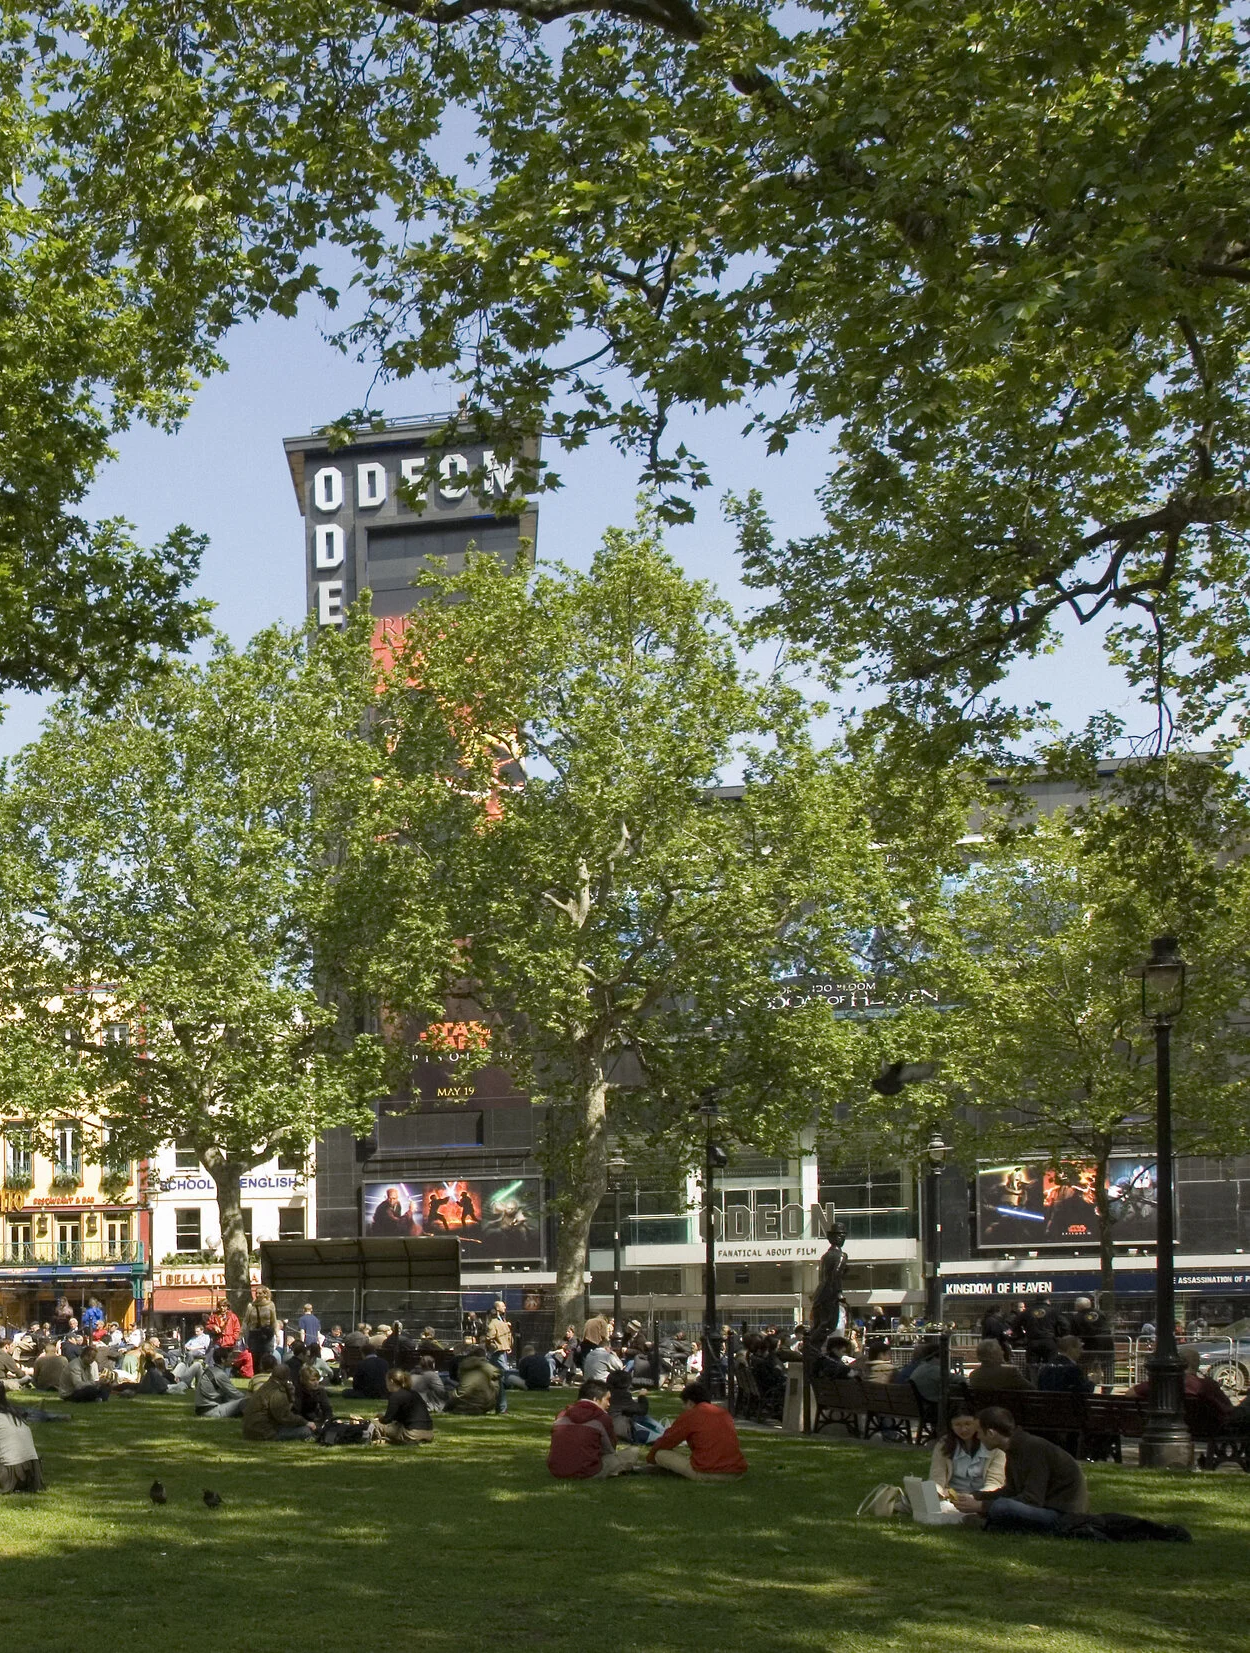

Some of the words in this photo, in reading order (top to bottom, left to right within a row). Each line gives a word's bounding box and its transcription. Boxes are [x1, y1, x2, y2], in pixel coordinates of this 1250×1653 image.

[827, 995, 846, 1005] OF
[437, 1087, 461, 1097] MAY
[464, 1086, 475, 1096] 19
[160, 1179, 215, 1191] SCHOOL
[239, 1177, 297, 1189] ENGLISH
[81, 1196, 95, 1204] BAR
[698, 1202, 835, 1243] ODEON
[717, 1249, 762, 1258] FANATICAL
[765, 1248, 792, 1257] ABOUT
[796, 1247, 817, 1256] FILM
[165, 1273, 208, 1285] BELLA
[1178, 1275, 1233, 1284] ASSASSINATION
[1234, 1275, 1244, 1283] OF
[946, 1283, 993, 1294] KINGDOM
[996, 1282, 1011, 1293] OF
[1013, 1281, 1053, 1293] HEAVEN
